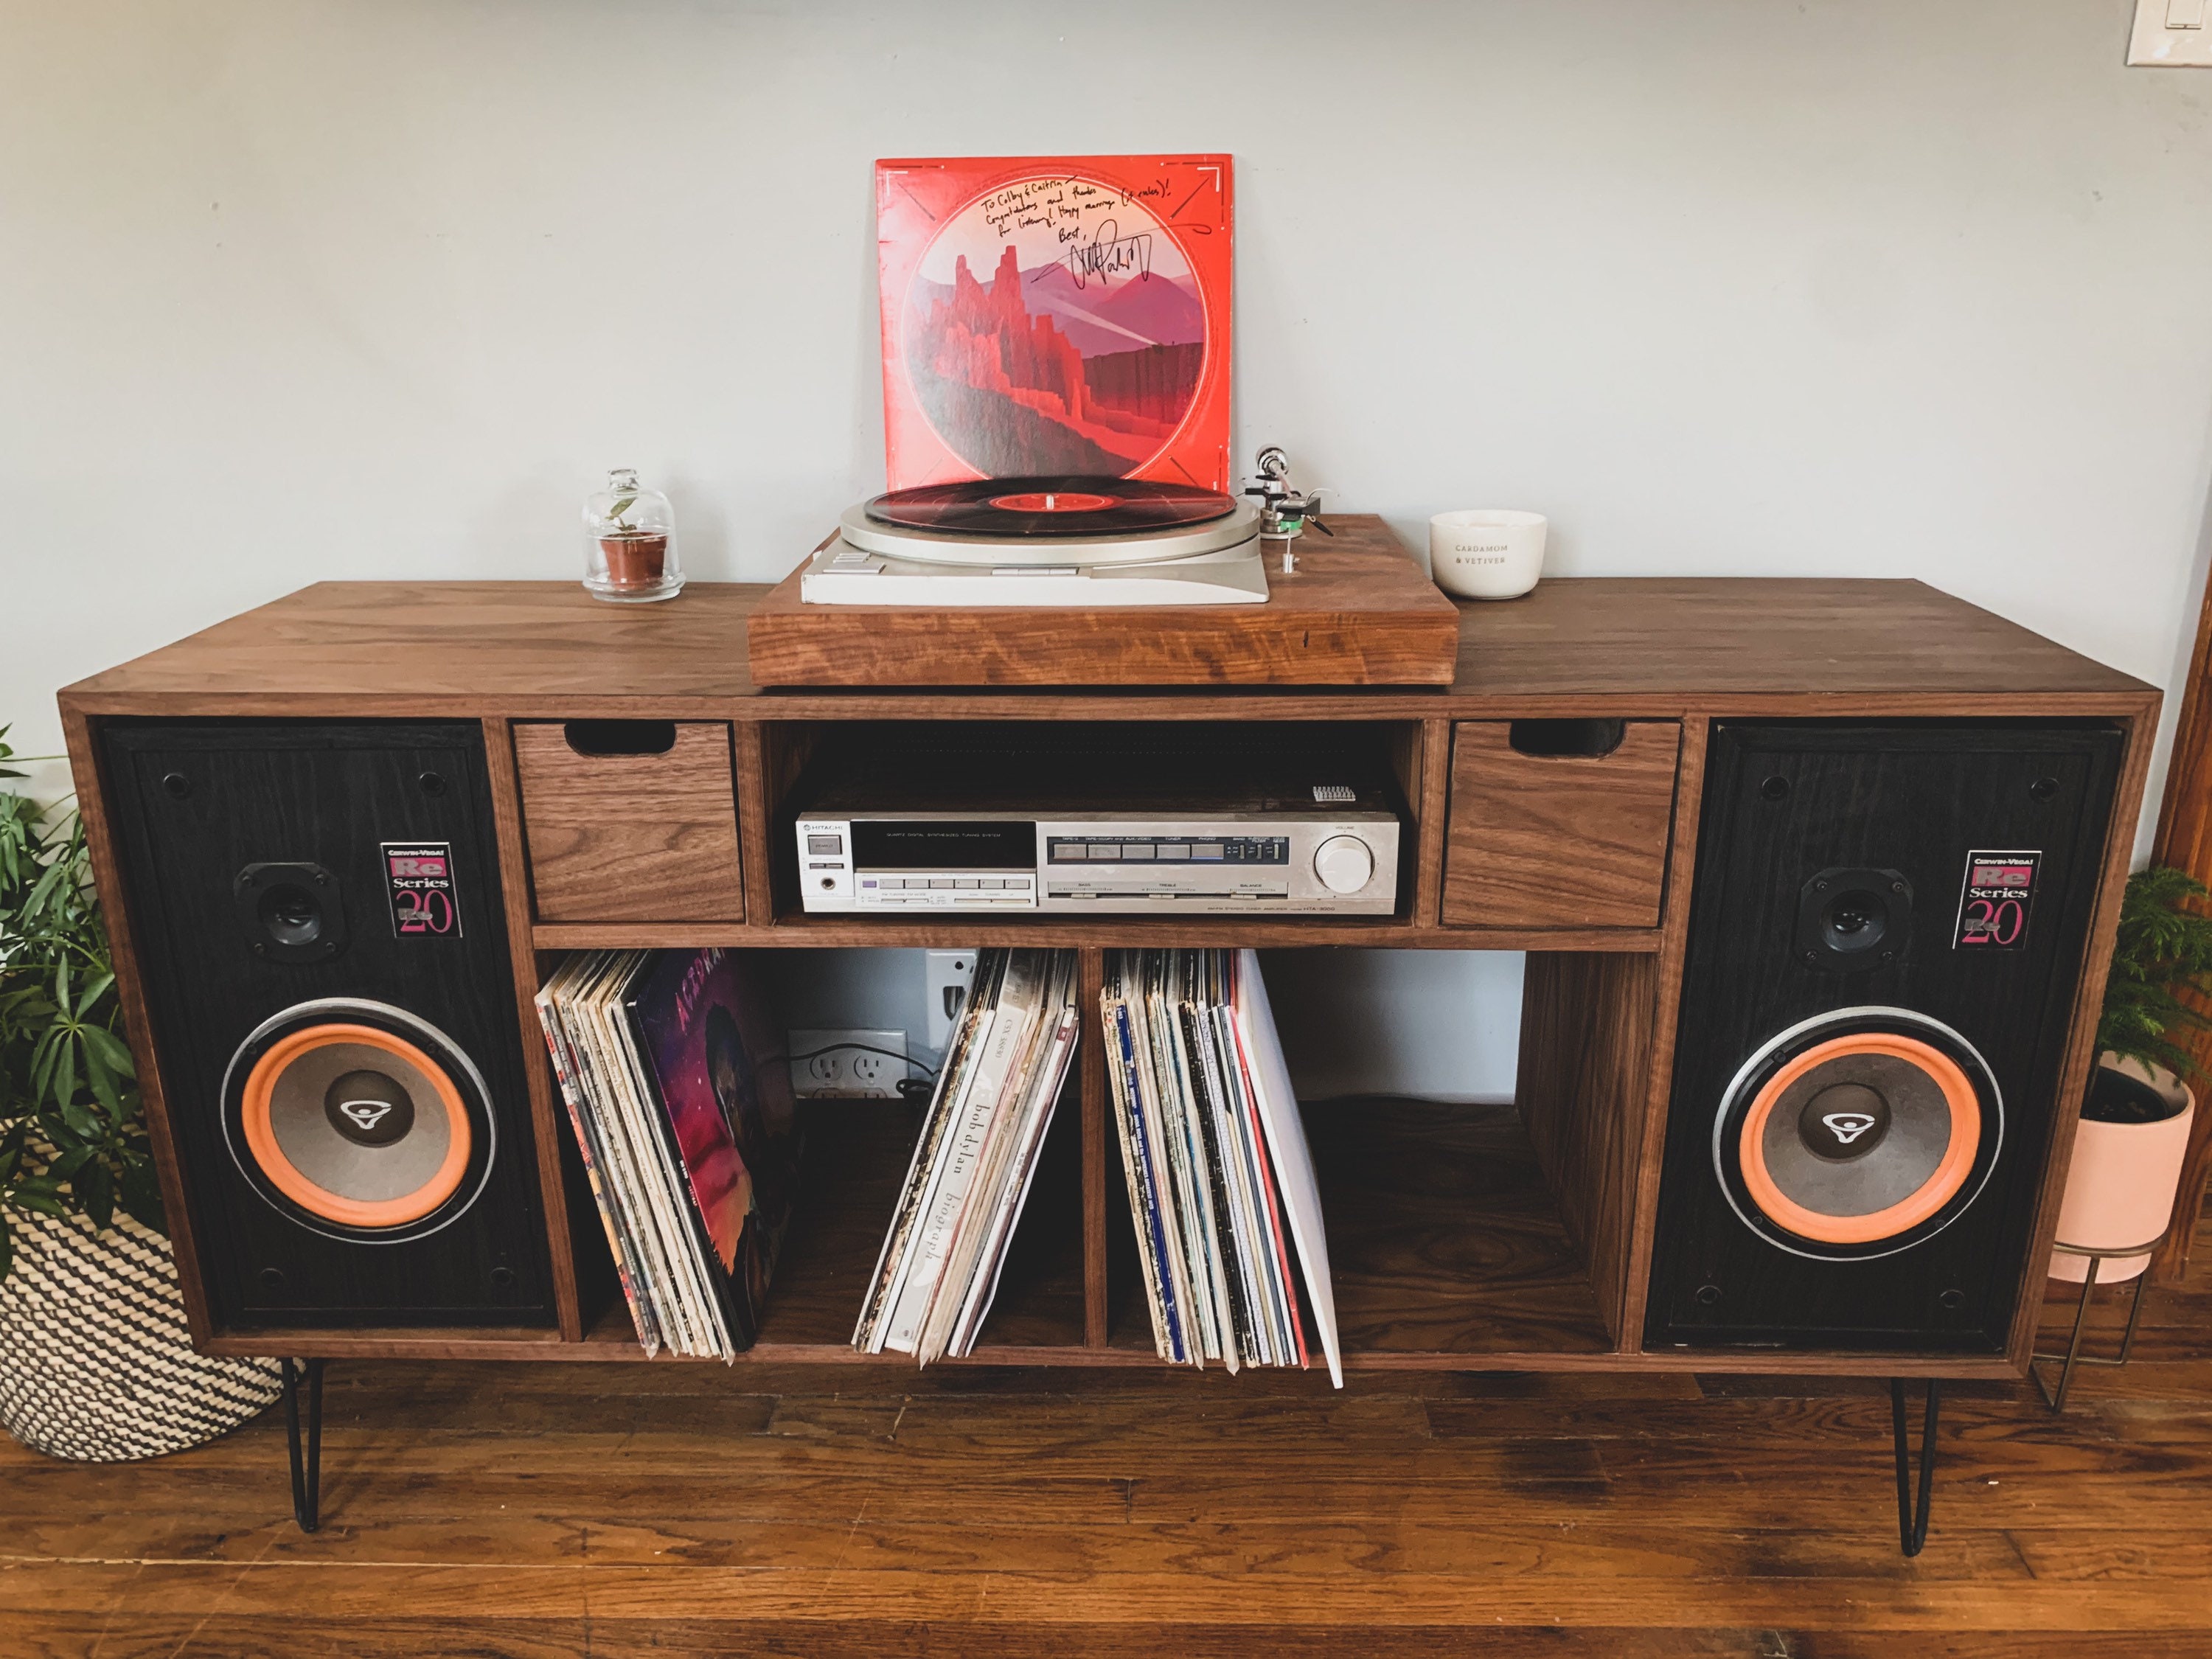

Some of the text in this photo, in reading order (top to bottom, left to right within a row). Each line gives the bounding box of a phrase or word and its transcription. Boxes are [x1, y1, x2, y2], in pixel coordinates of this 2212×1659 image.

[981, 199, 995, 212] To
[998, 190, 1024, 211] Colby
[1047, 190, 1063, 206] and
[394, 858, 443, 875] Re
[393, 877, 449, 888] Series
[1976, 868, 2027, 885] Re
[1969, 887, 2028, 898] Series
[396, 889, 453, 933] 20
[1961, 900, 2023, 945] 20
[949, 1102, 990, 1178] bob dylan
[922, 1191, 961, 1262] biograph
